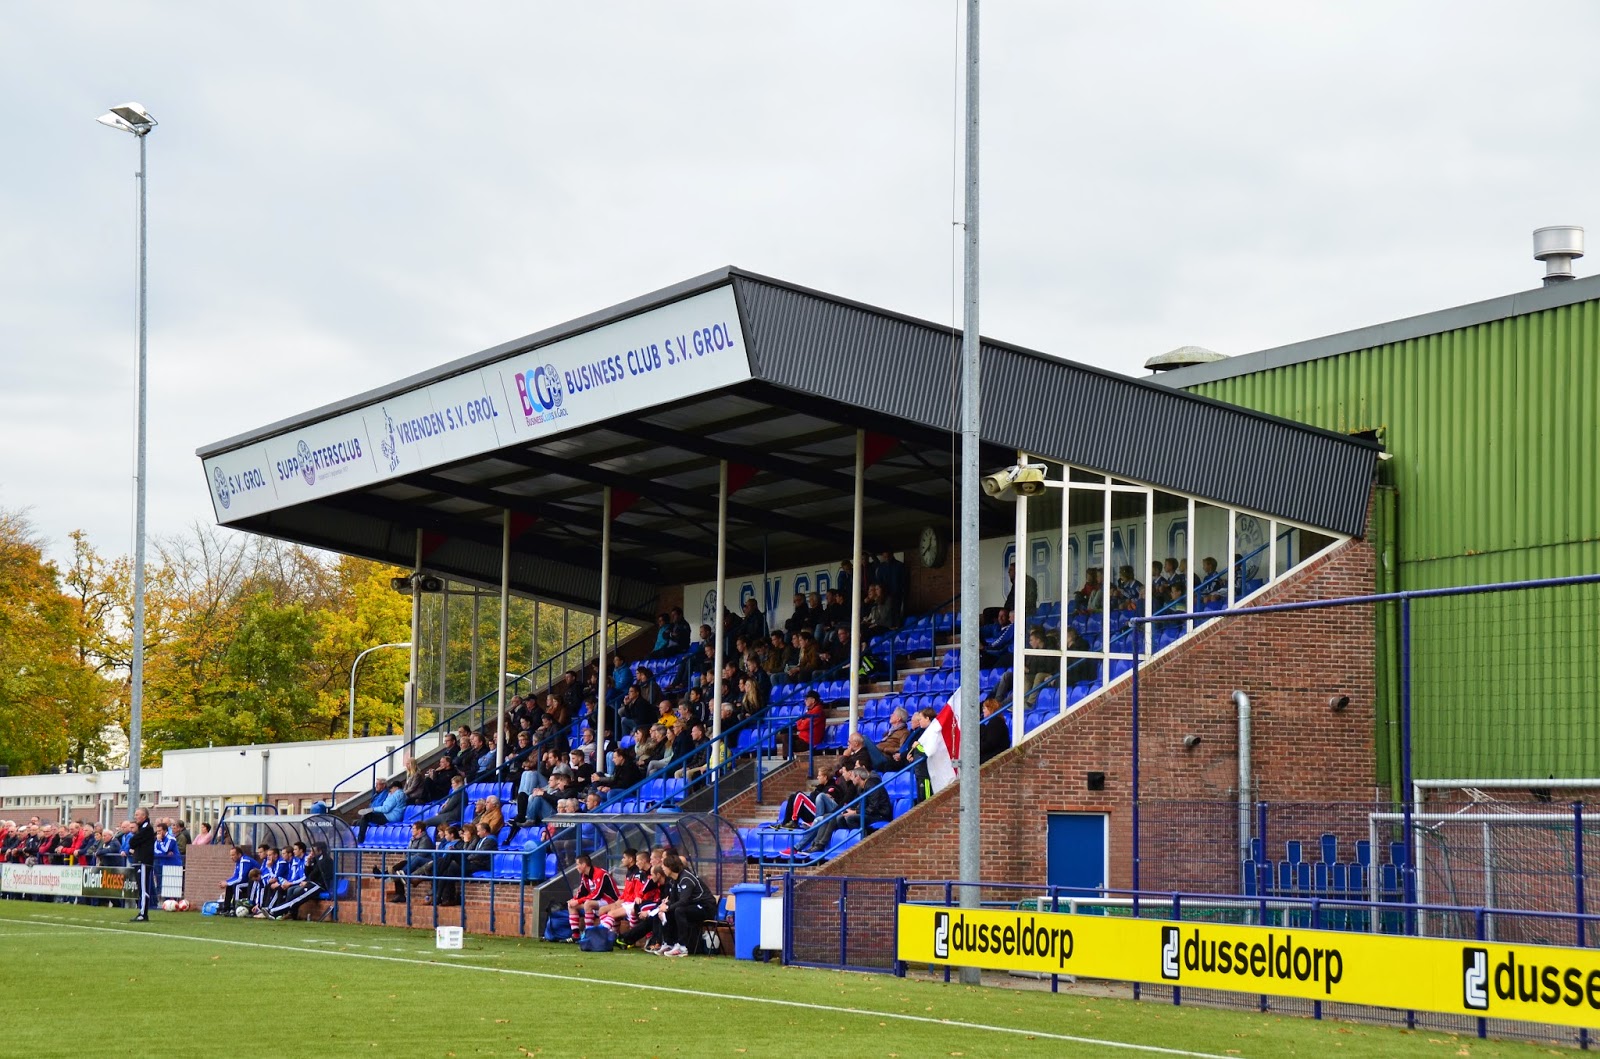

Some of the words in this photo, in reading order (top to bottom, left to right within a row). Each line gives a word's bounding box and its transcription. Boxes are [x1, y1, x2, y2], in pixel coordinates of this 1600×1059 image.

[565, 354, 625, 395] BUSINESS
[627, 344, 662, 376] CLUB
[396, 411, 446, 445] VRIENDEN
[951, 913, 1074, 969] dusseldorp
[1183, 928, 1344, 995] dusseldorp
